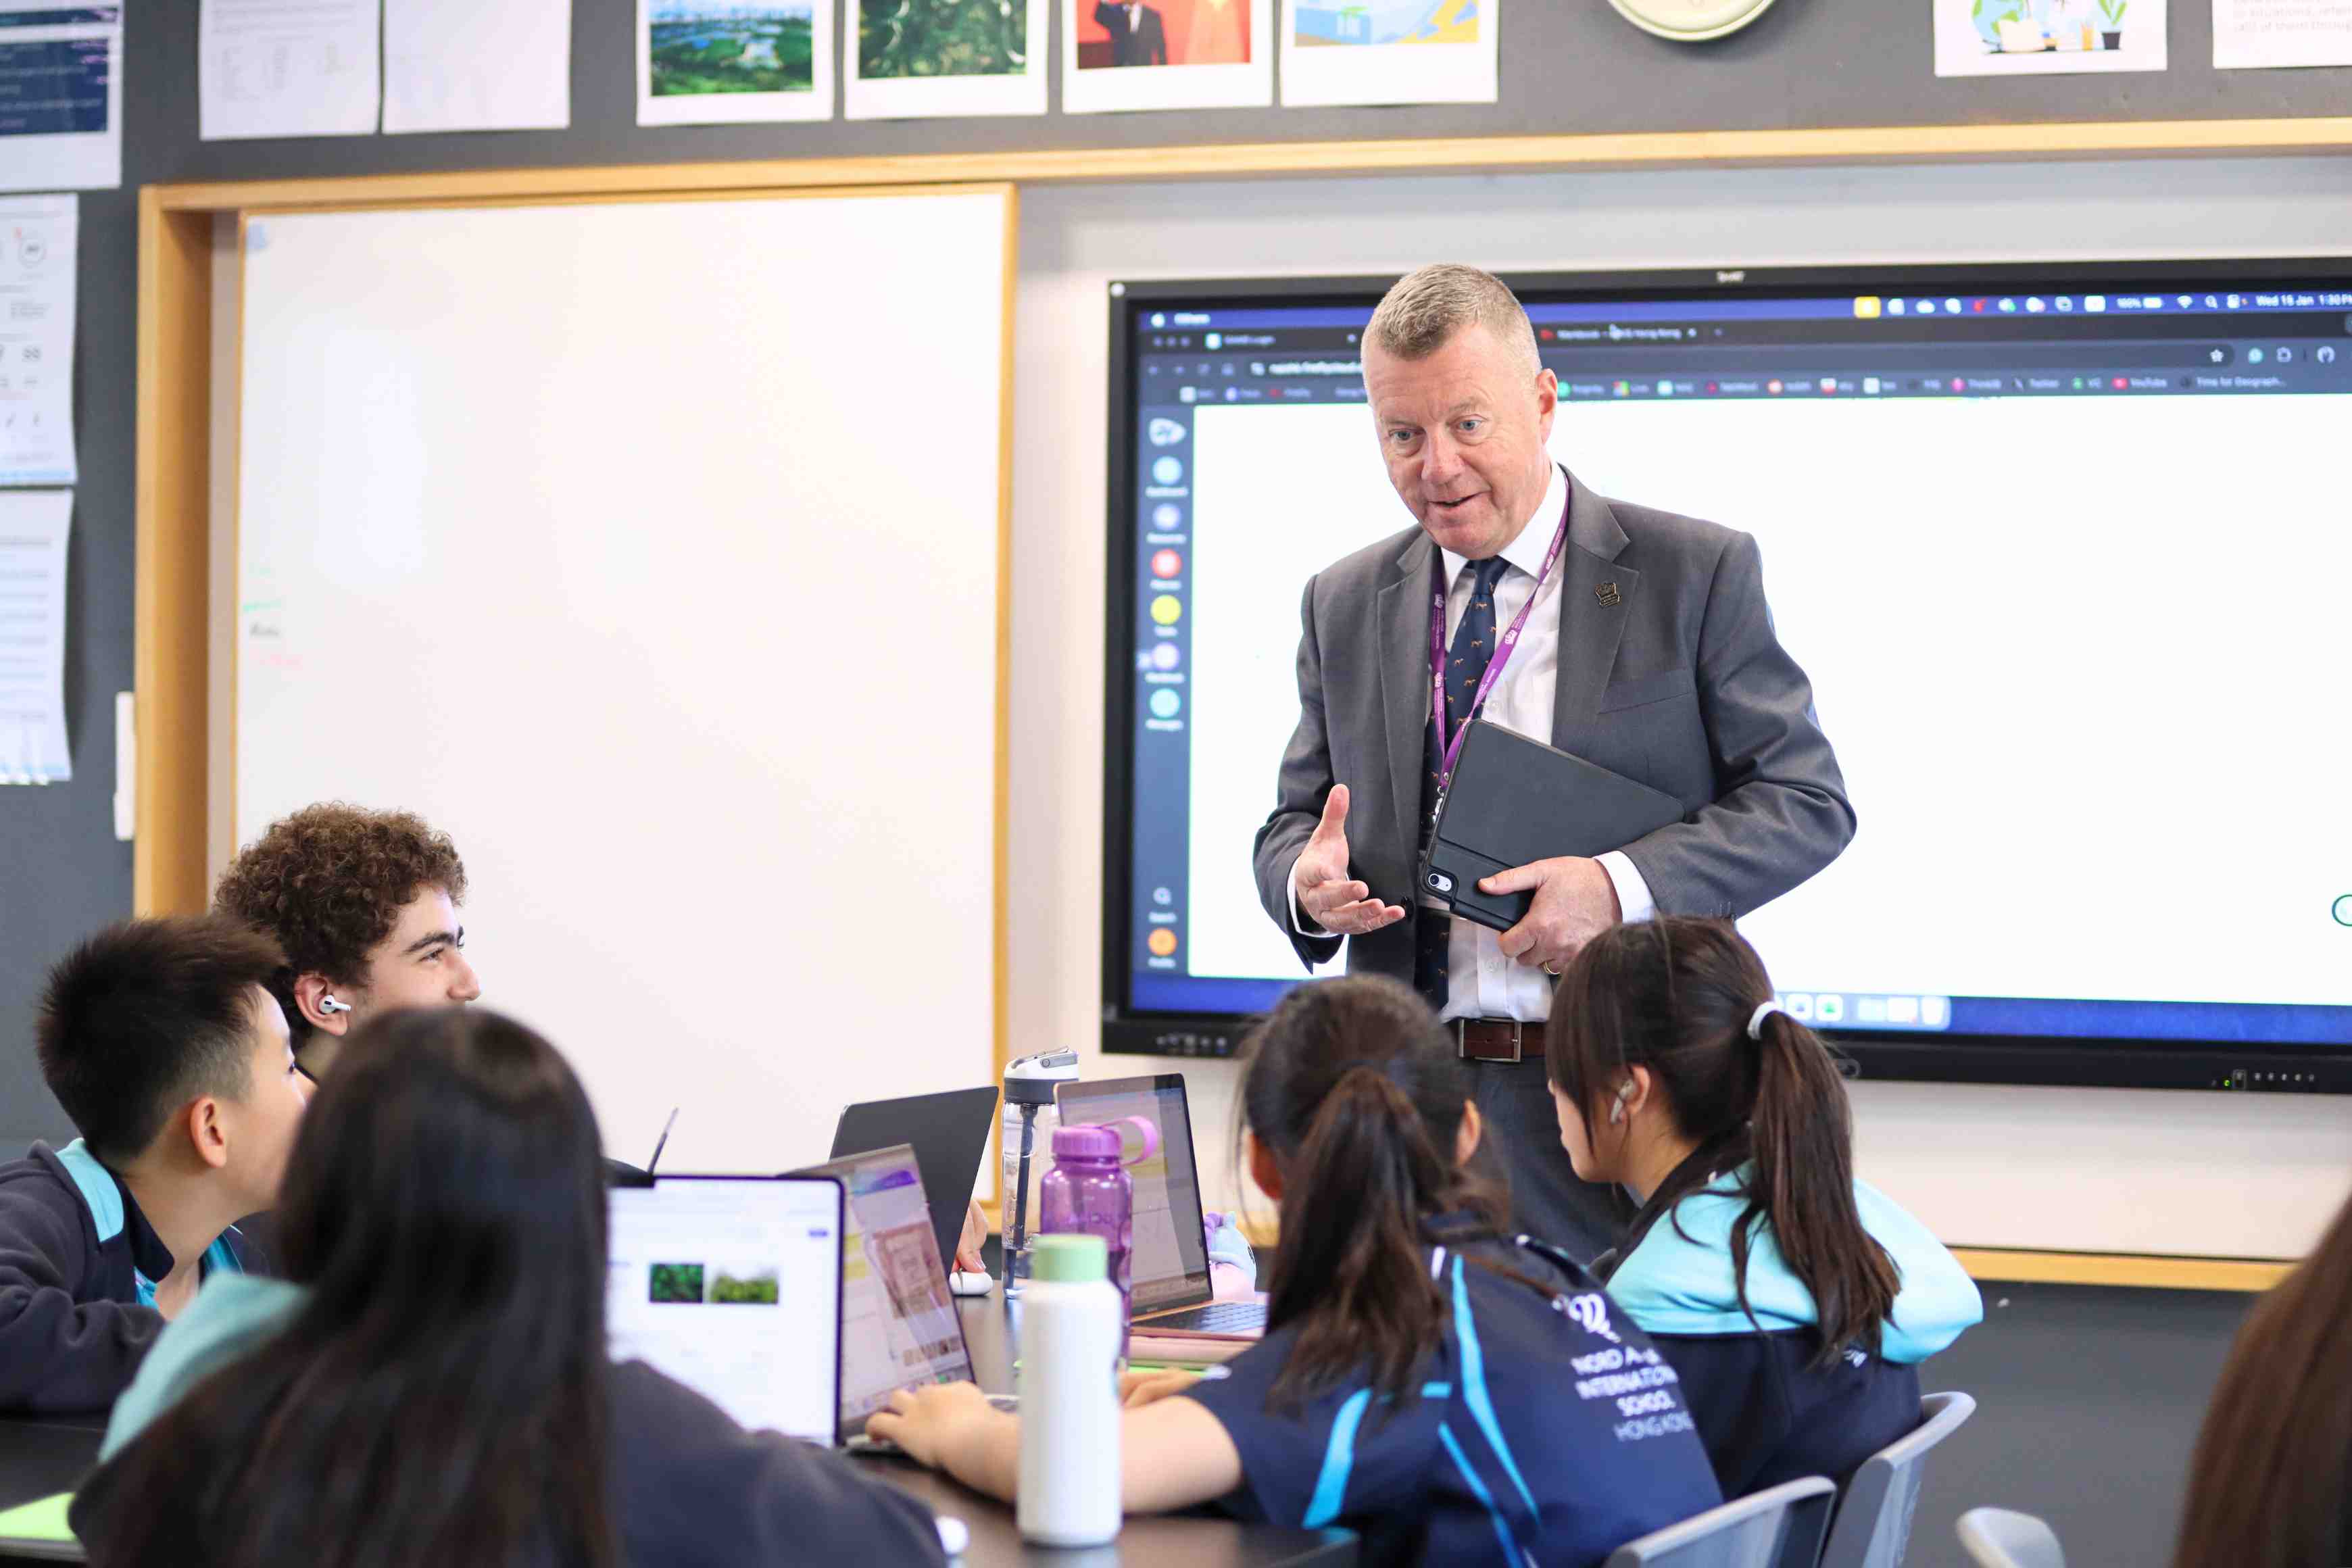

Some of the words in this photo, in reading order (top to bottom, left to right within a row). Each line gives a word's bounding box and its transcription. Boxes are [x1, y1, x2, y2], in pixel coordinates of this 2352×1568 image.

[2256, 295, 2279, 306] Wed
[2296, 295, 2315, 306] Jan
[1617, 1390, 1676, 1416] SCHOOL
